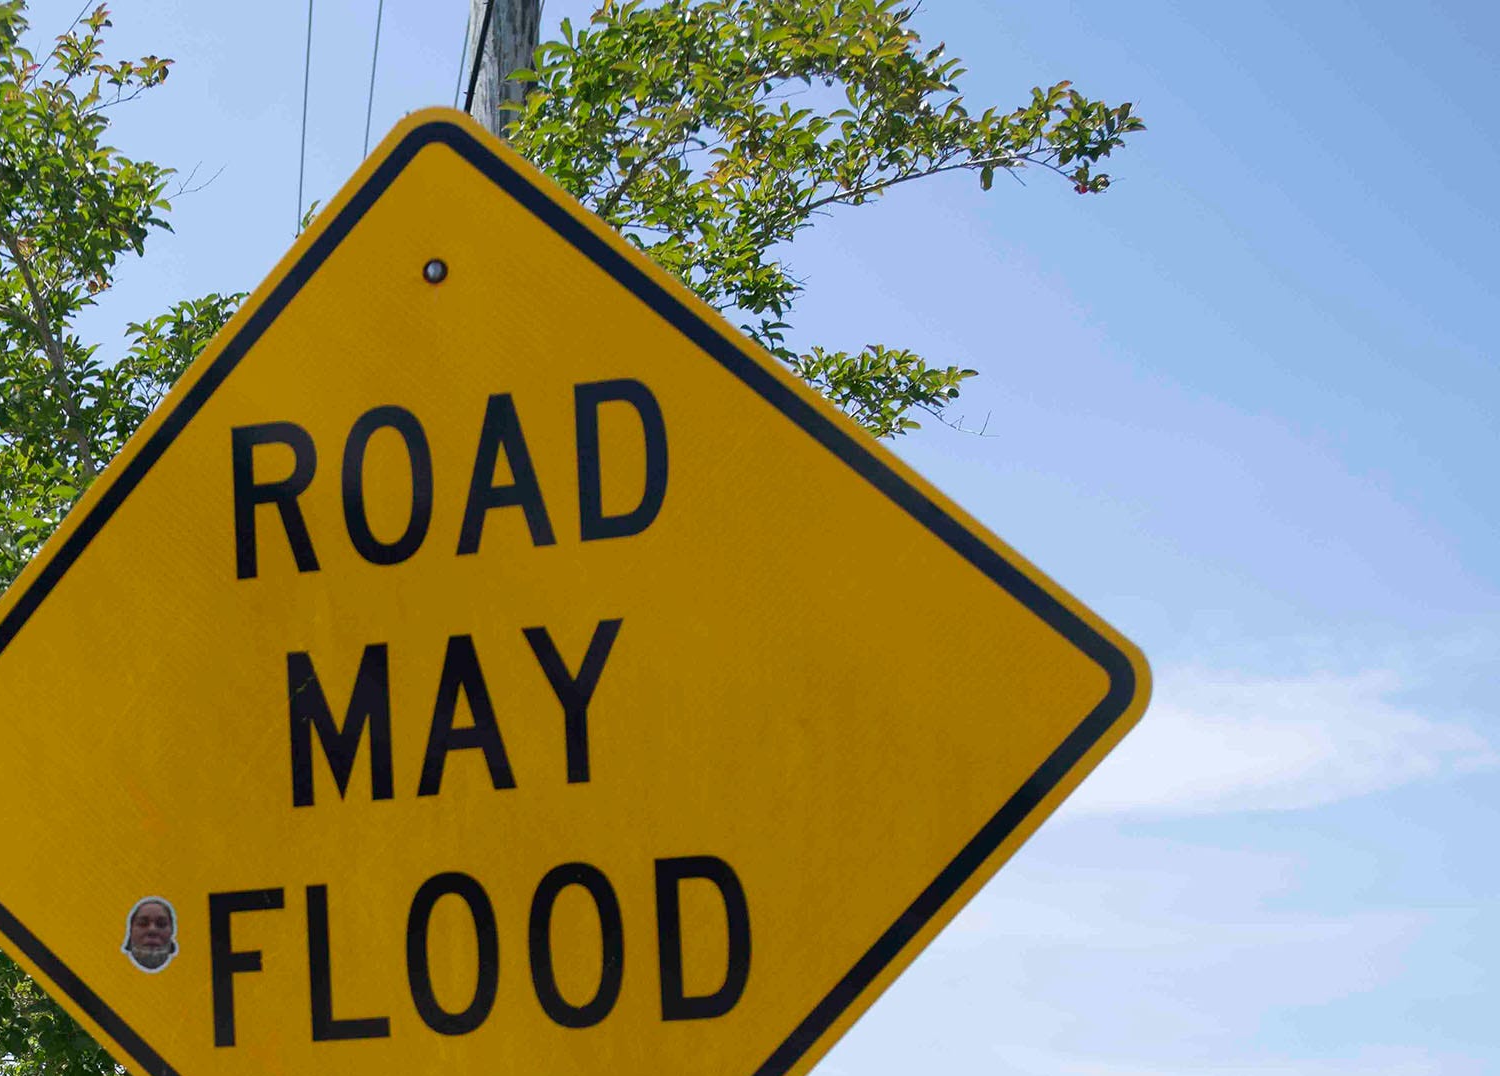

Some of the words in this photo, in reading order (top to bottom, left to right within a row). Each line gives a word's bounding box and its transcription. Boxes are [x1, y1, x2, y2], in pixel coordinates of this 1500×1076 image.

[231, 377, 669, 580] ROAD
[287, 617, 624, 807] MAY
[208, 855, 752, 1047] FLOOD
